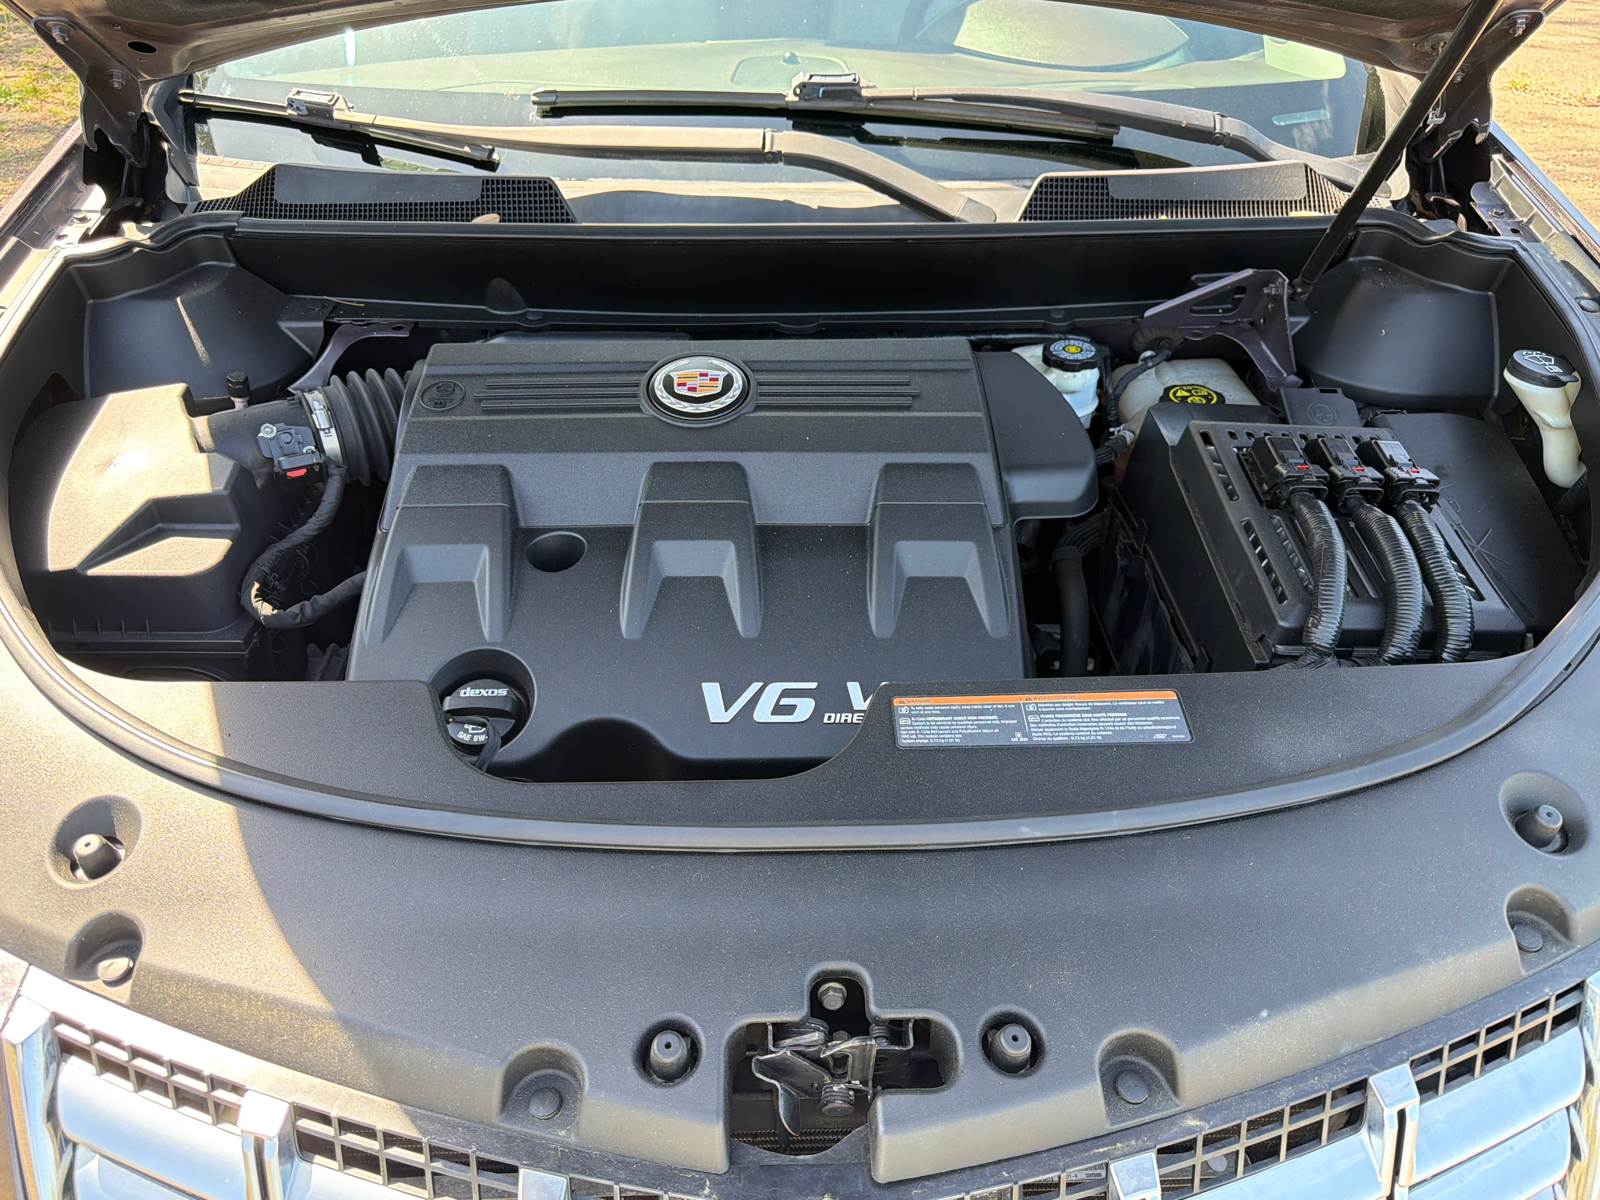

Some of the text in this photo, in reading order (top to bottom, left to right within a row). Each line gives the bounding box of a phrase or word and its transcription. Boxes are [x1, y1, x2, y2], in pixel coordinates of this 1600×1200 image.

[459, 686, 509, 697] dexos
[702, 682, 818, 723] V6
[457, 731, 472, 740] SAE
